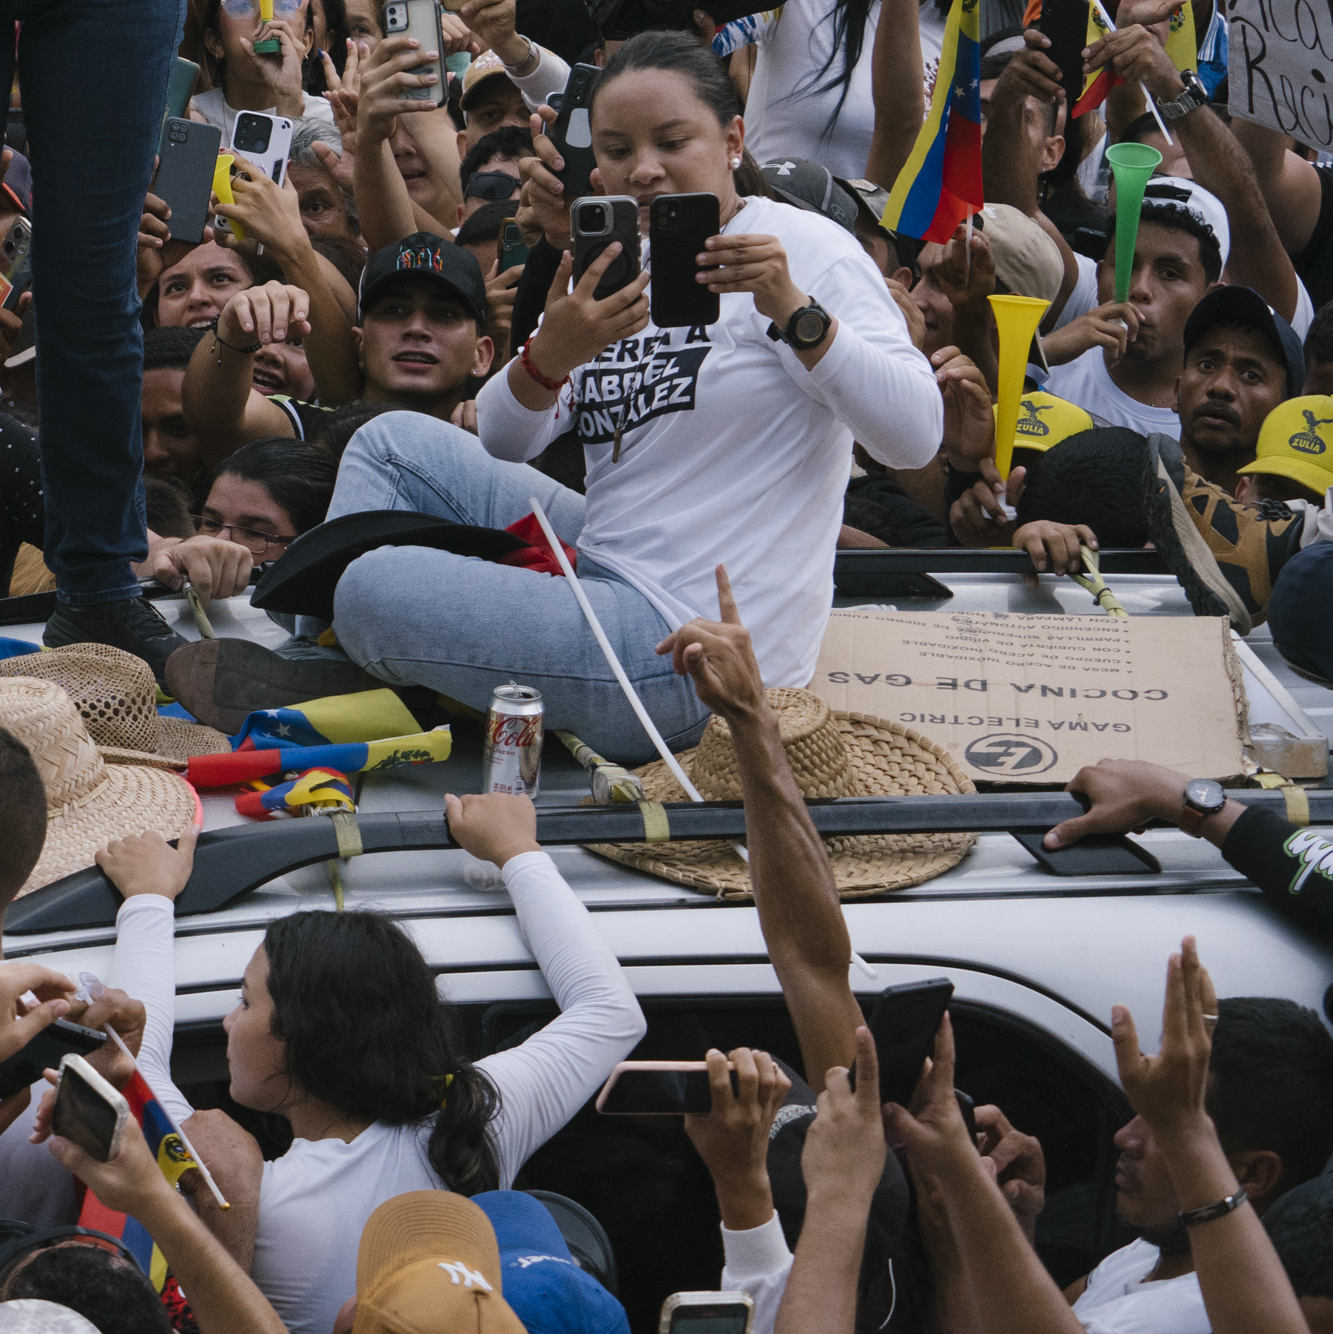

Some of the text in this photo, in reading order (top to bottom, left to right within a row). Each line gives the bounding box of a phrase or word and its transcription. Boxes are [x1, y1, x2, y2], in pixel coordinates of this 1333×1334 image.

[1016, 423, 1044, 435] ZULIA
[1291, 438, 1321, 453] ZULIA
[901, 639, 983, 653] INOXIDABLE
[918, 651, 1000, 663] INOXIDABLE
[990, 648, 1035, 658] ACERO
[1005, 660, 1053, 669] ACERO
[1065, 656, 1121, 664] CUERPO
[828, 671, 1169, 701] COCINA DE GAS
[899, 712, 1132, 733] GAMA ELECTRIC
